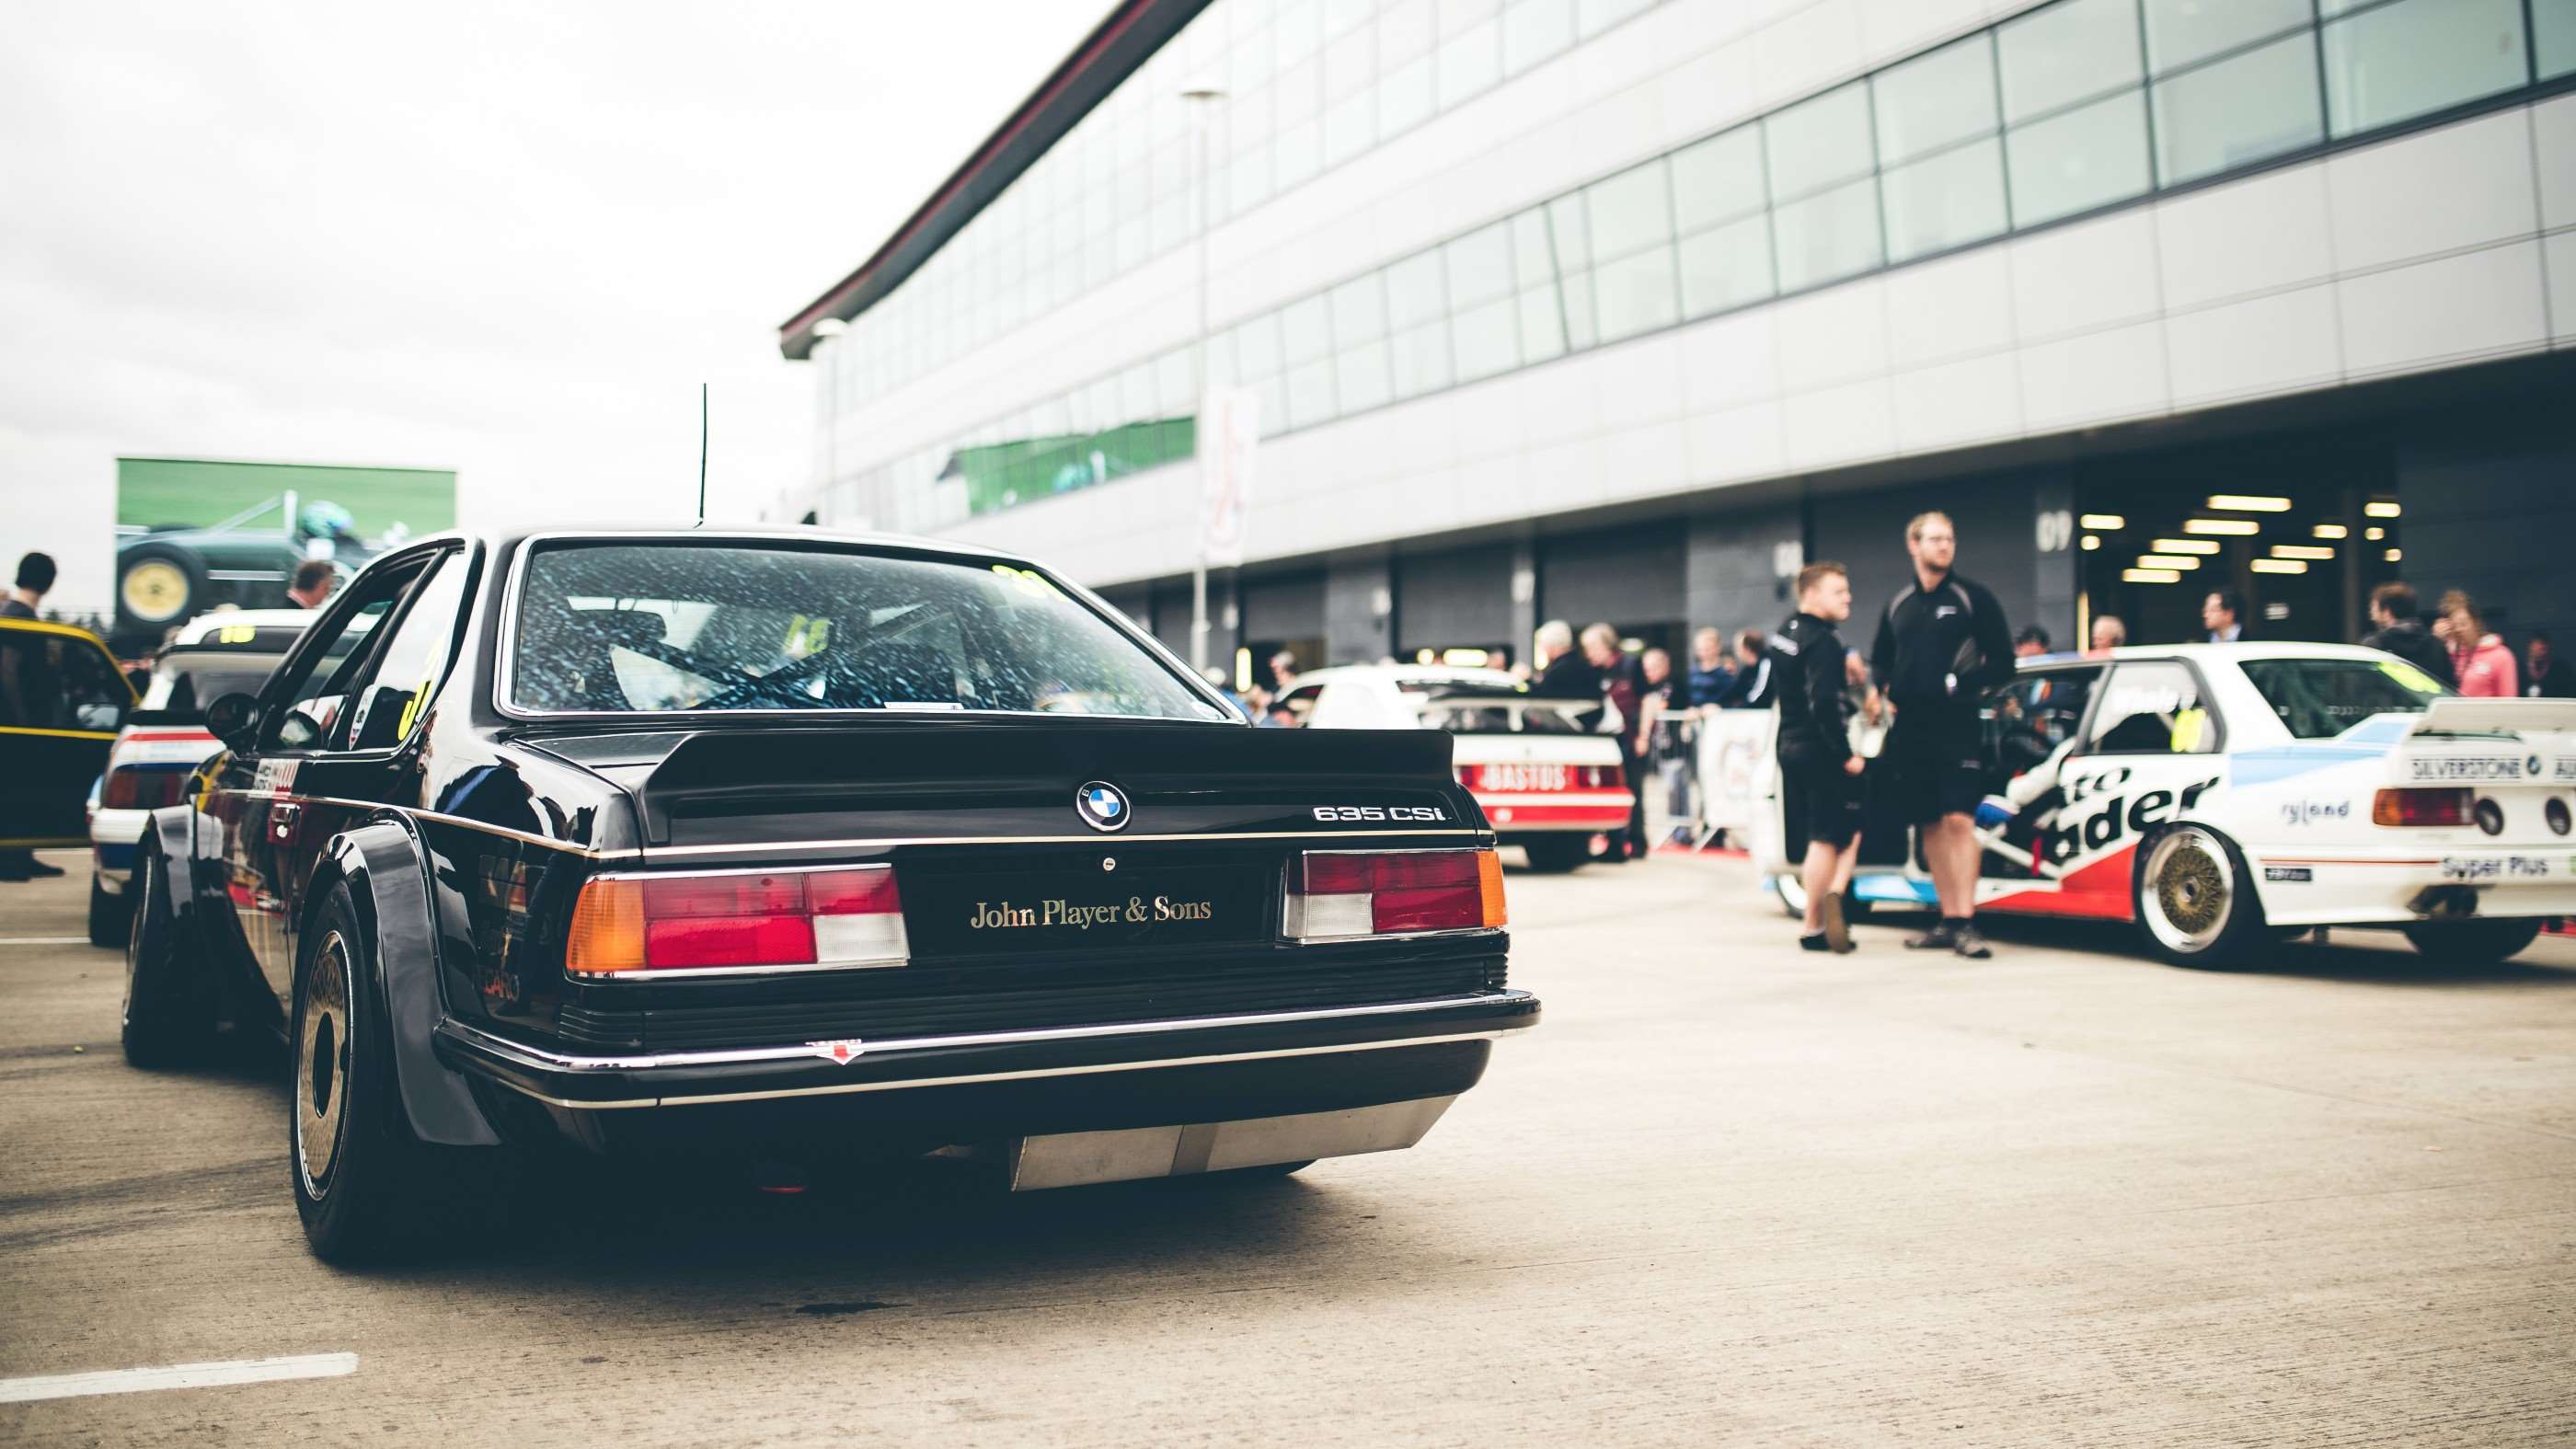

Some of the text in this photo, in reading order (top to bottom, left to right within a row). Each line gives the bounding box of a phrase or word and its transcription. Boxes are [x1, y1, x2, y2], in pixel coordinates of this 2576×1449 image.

[2036, 512, 2072, 551] 09
[2412, 758, 2521, 779] SILVERSTONE
[1313, 806, 1446, 822] 635 CSi
[2443, 857, 2548, 882] Super Plus
[971, 895, 1212, 930] John Player & Sons
